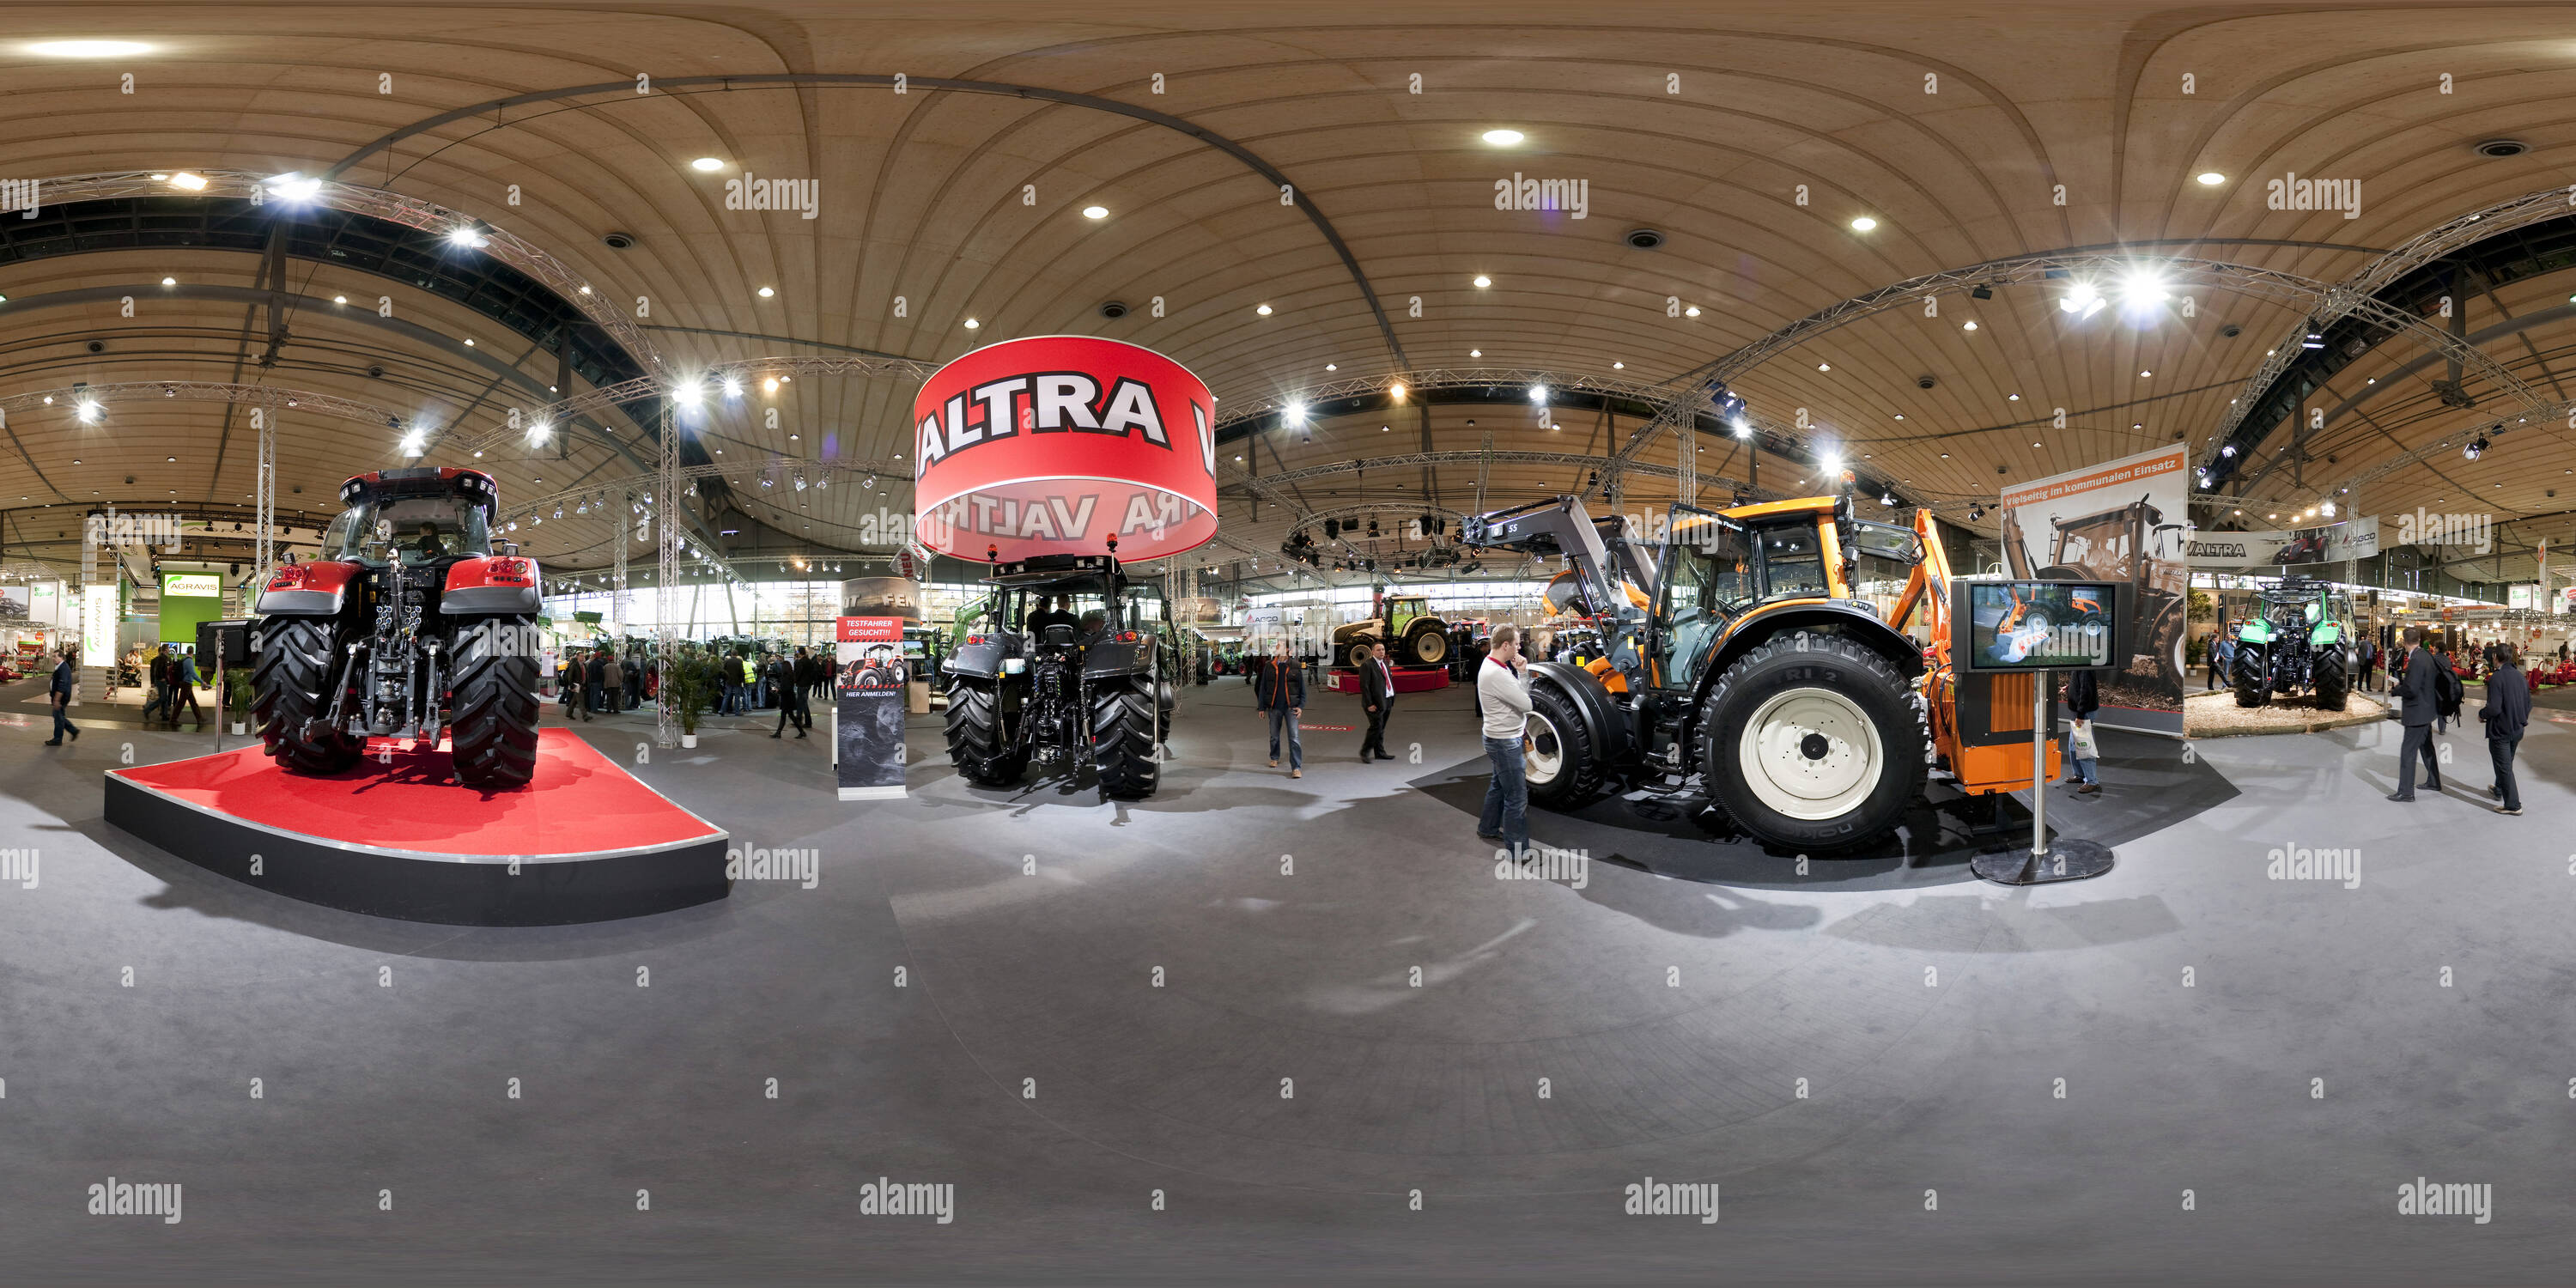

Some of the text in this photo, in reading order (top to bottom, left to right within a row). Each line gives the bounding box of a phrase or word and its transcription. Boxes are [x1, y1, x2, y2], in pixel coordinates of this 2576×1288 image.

[2006, 459, 2176, 506] Vielseitig im kommunalen Einsatz
[1723, 520, 1743, 532] Finland
[900, 553, 914, 577] NEU
